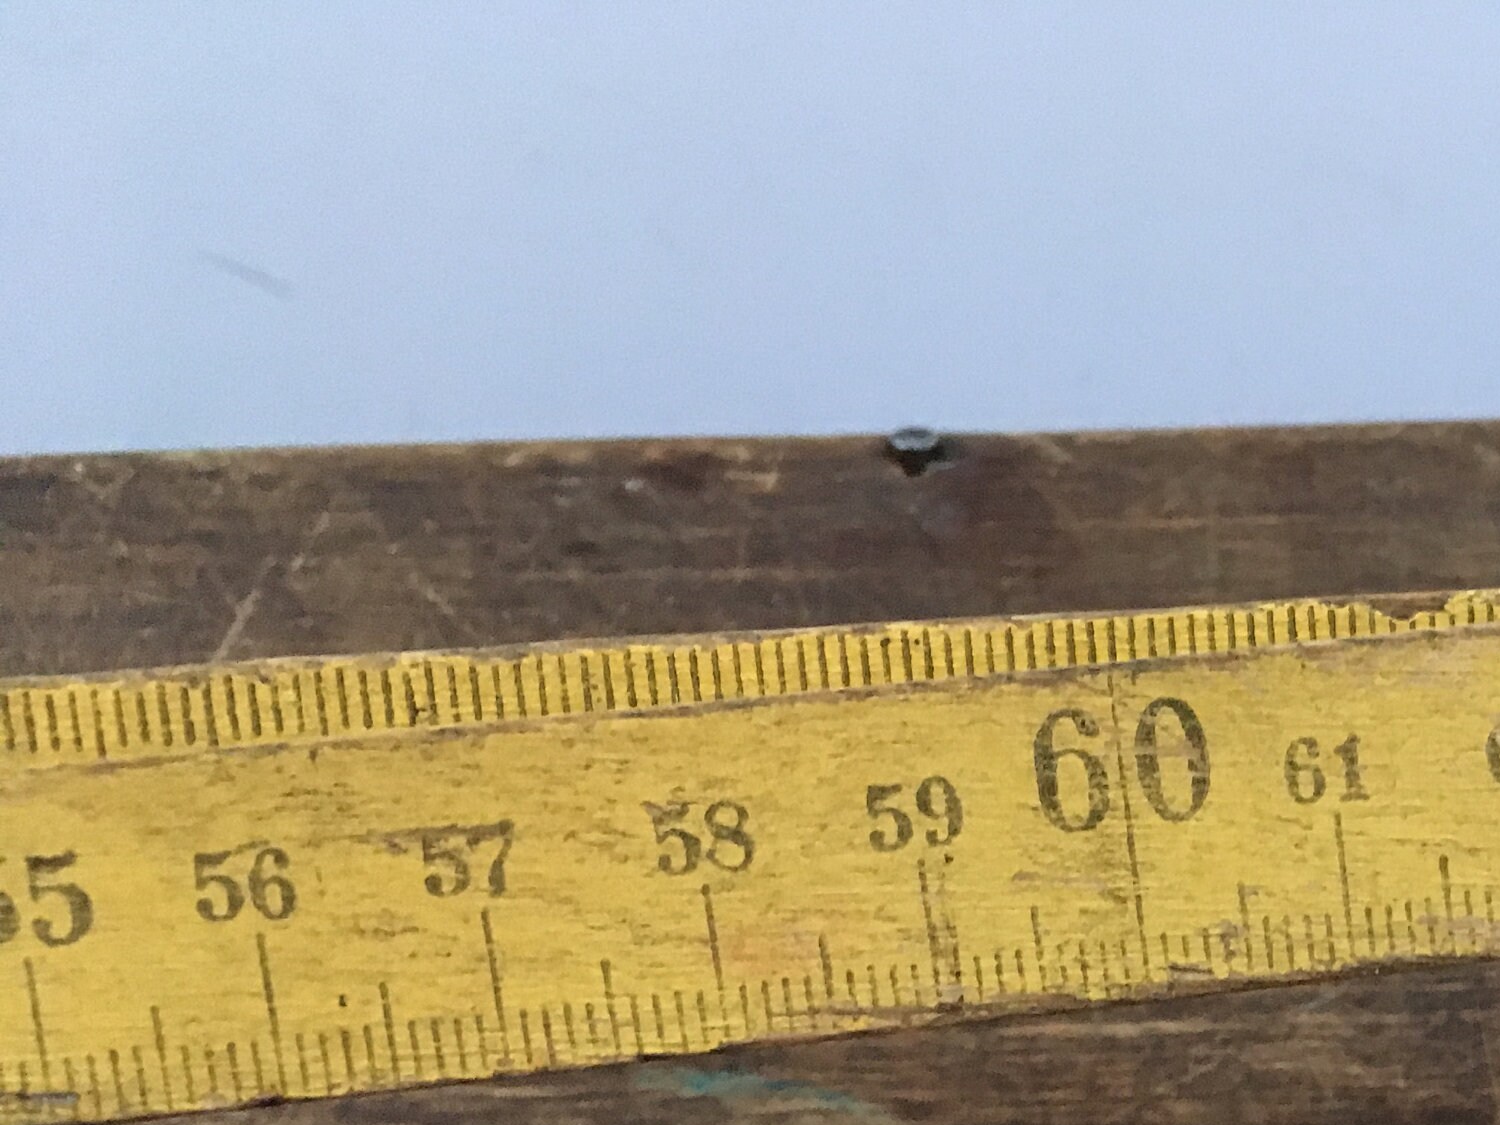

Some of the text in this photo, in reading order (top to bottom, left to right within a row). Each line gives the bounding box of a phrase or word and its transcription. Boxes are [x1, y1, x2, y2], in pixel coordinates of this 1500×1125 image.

[193, 840, 297, 923] 56
[420, 818, 515, 898] 57
[647, 797, 757, 877] 58
[865, 775, 964, 853] 59
[1032, 697, 1211, 833] 60
[1284, 732, 1370, 804] 61
